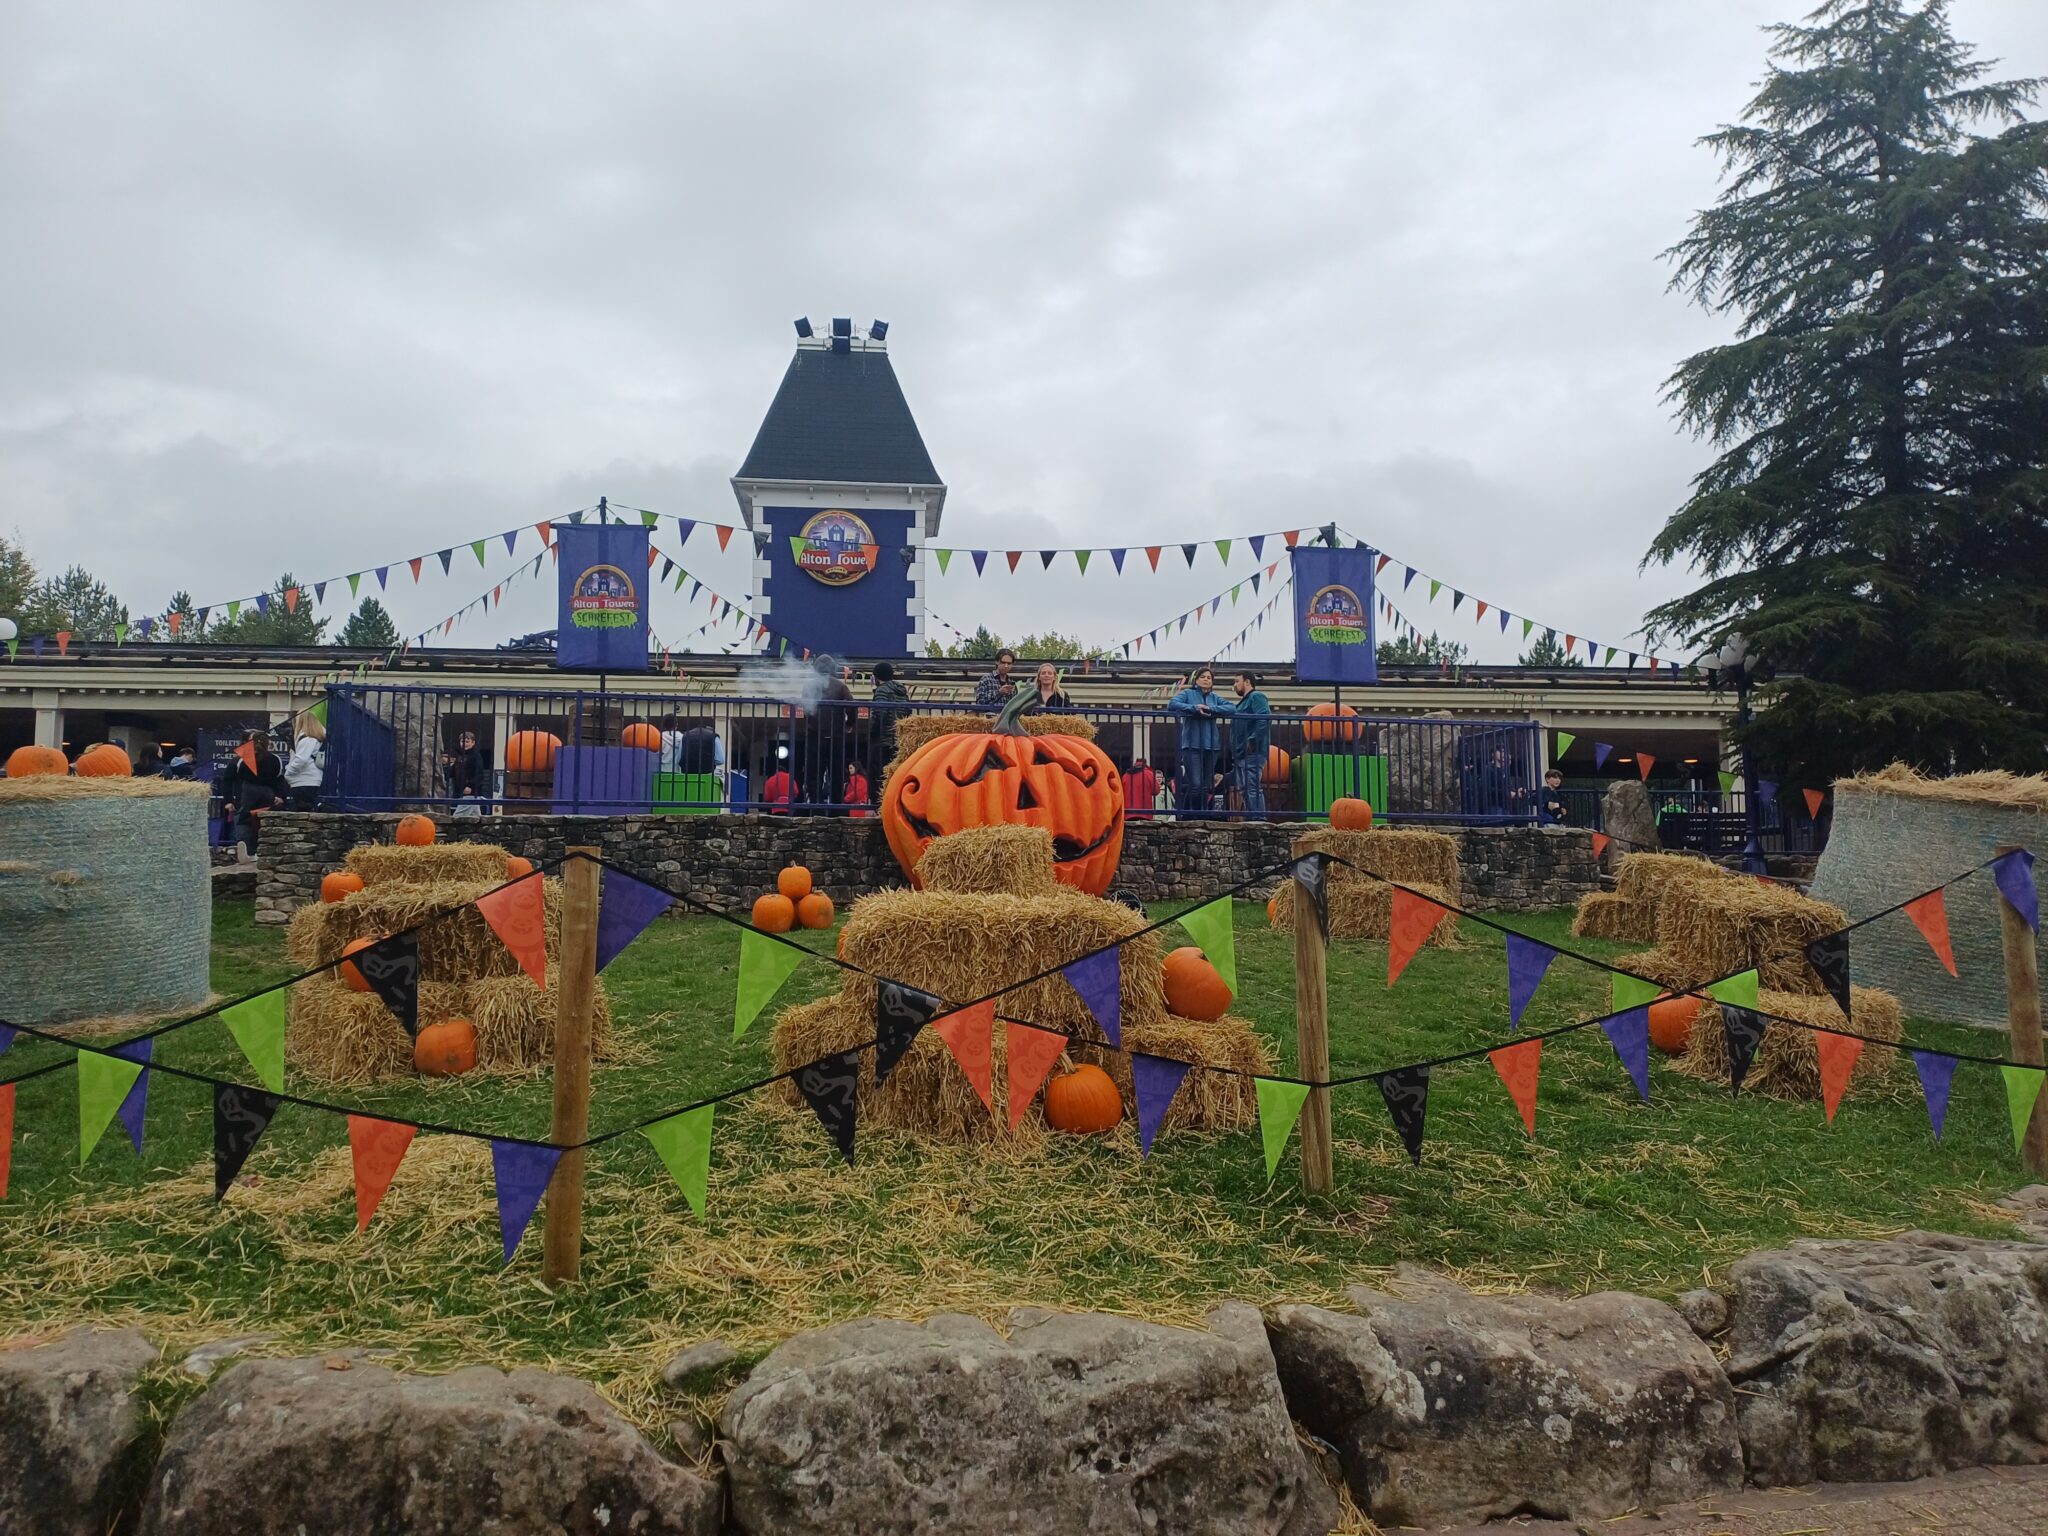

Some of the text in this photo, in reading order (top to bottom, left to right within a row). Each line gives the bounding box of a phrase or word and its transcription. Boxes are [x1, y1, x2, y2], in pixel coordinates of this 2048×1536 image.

[800, 553, 868, 565] Alton Towe
[573, 599, 600, 608] Alton
[1310, 616, 1334, 625] Alton
